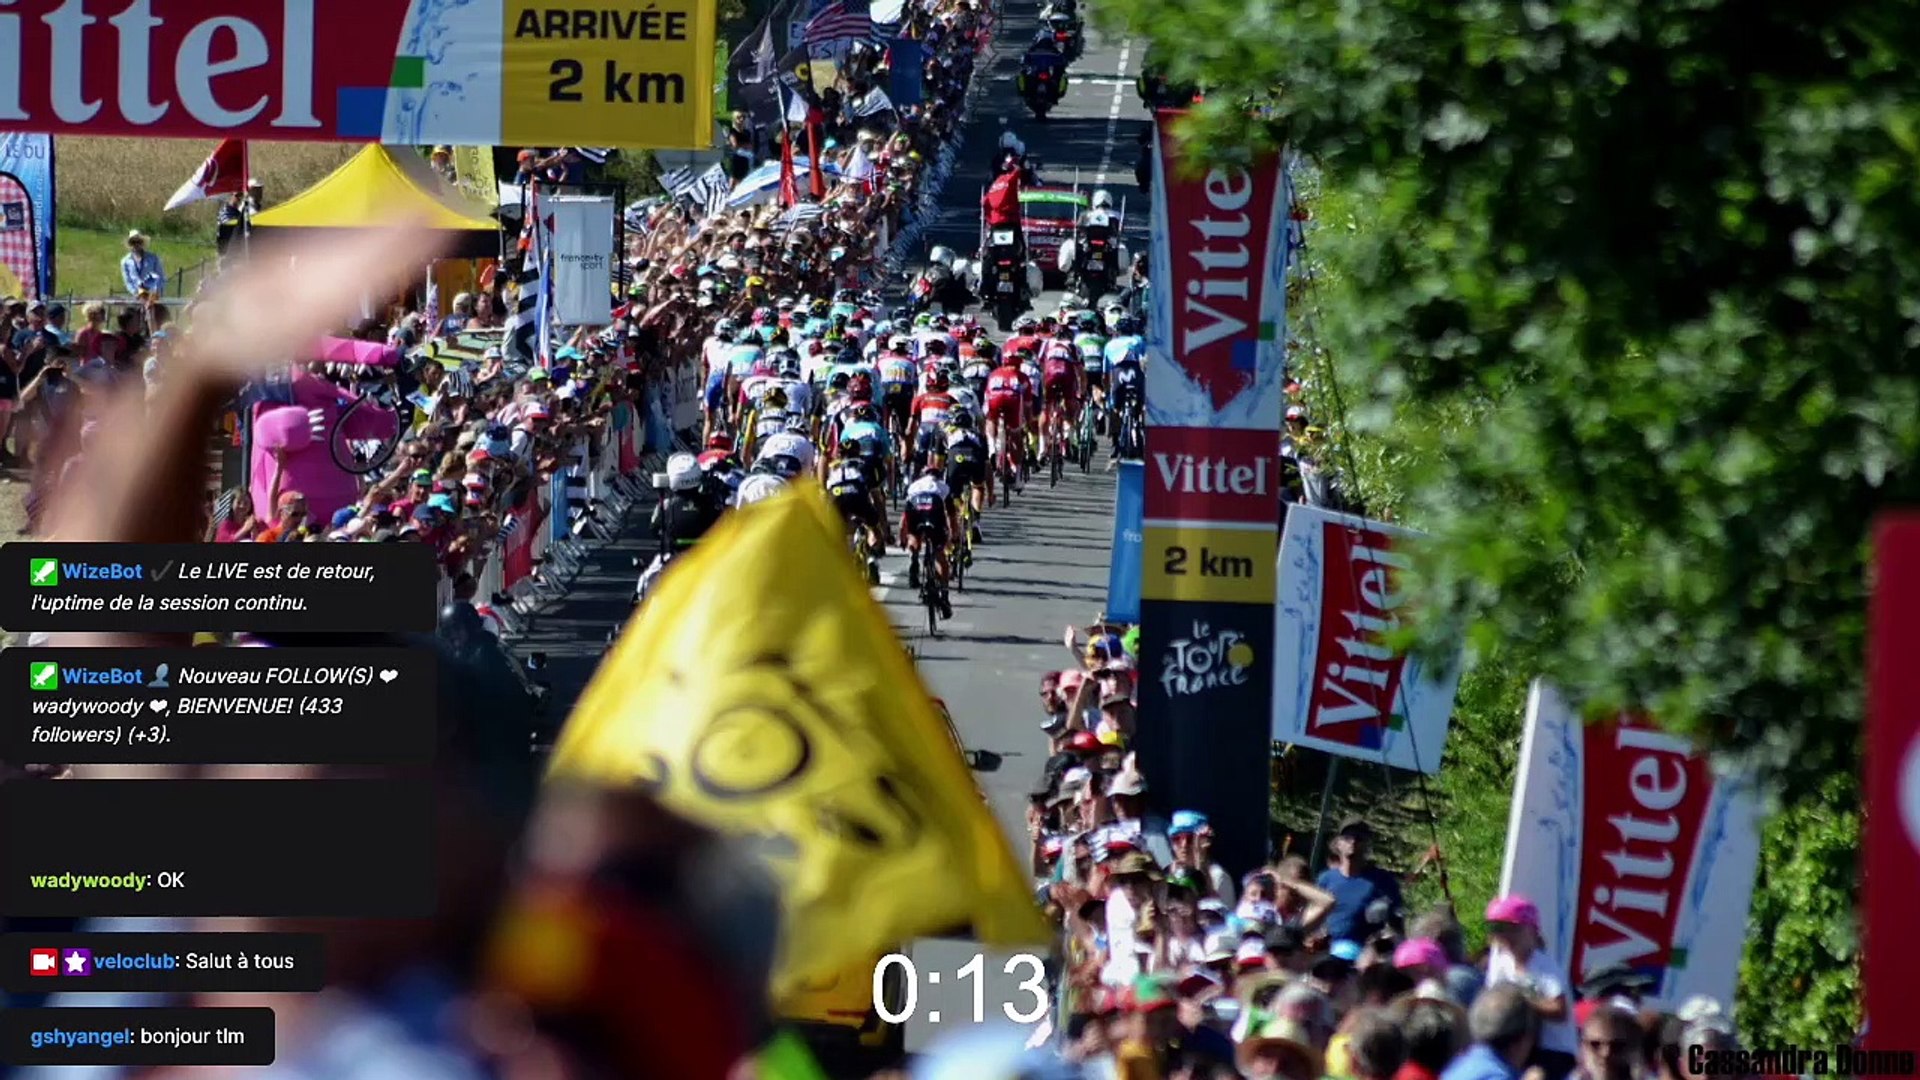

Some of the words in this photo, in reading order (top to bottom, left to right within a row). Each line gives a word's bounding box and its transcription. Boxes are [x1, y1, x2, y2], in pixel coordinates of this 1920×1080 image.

[515, 4, 687, 41] ARRIVÉE
[0, 0, 322, 128] ittel
[549, 59, 583, 102] 2
[604, 60, 685, 104] km
[1182, 163, 1253, 356] Vitte
[1153, 452, 1268, 496] Vittel
[1164, 546, 1187, 575] 2
[1200, 547, 1253, 578] km
[1582, 727, 1694, 982] Vittel
